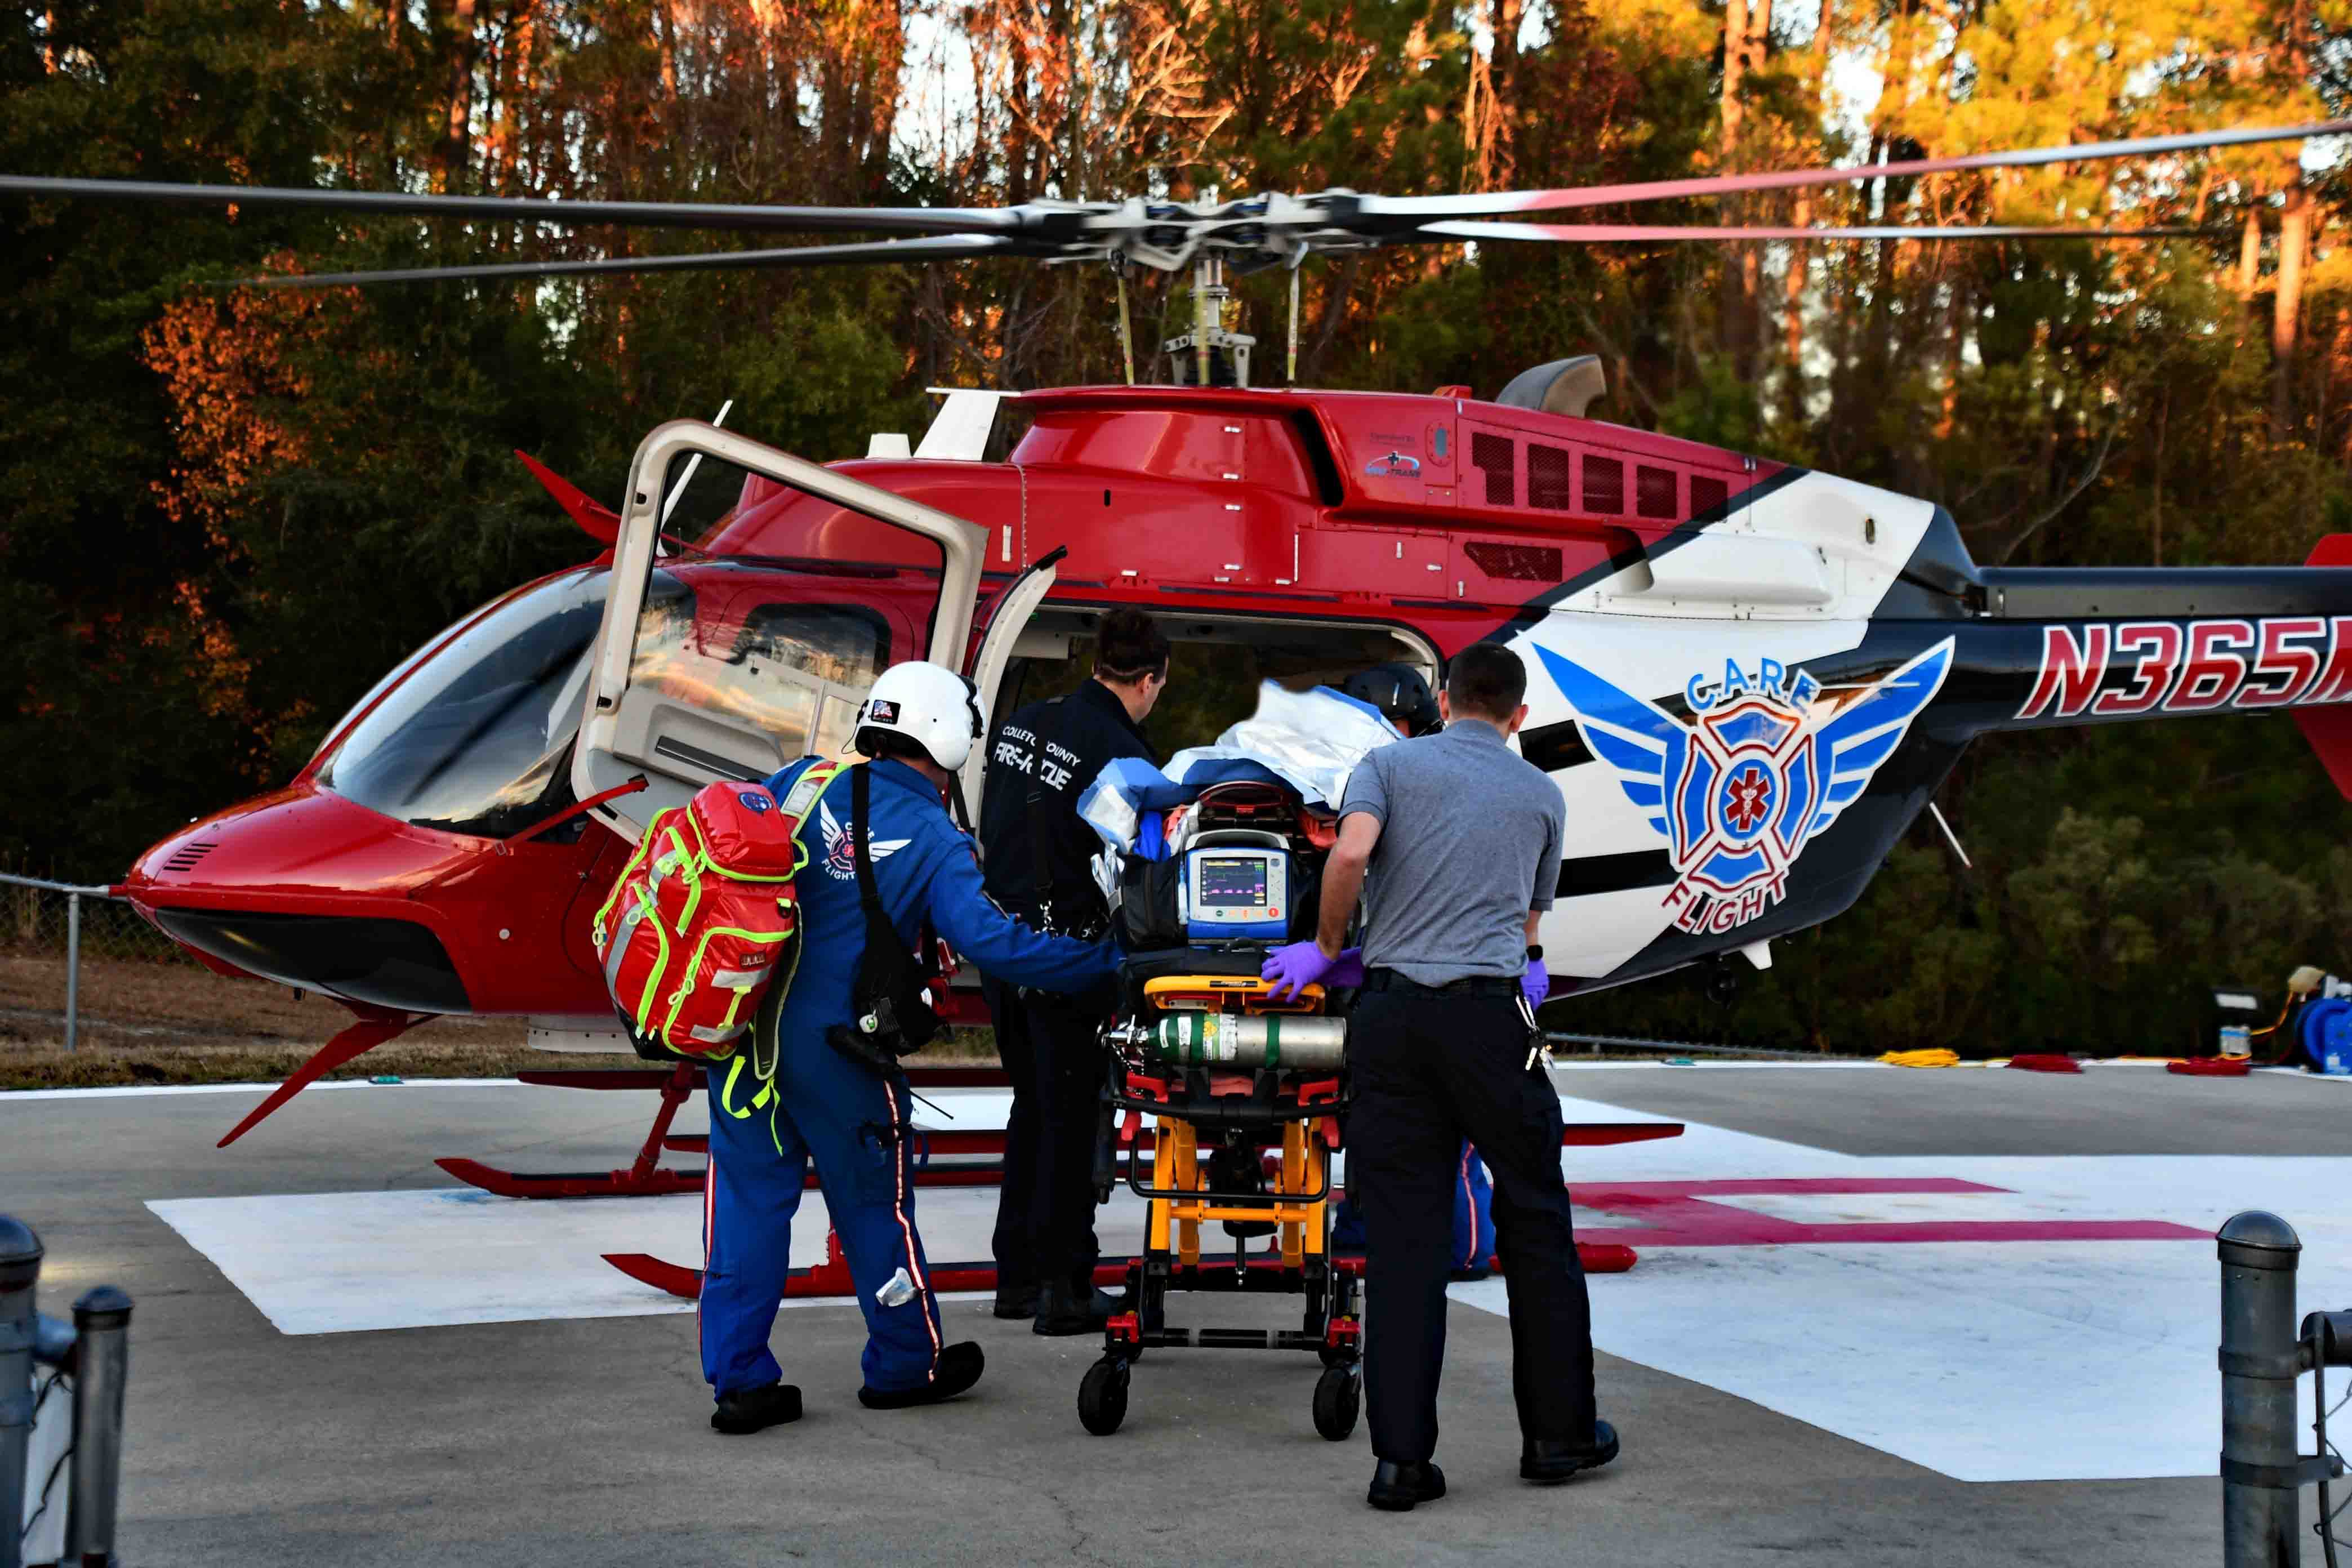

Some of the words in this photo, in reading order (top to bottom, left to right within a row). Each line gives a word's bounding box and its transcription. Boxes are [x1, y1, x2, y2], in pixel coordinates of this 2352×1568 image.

[1046, 741, 1081, 767] OUNTY
[822, 858, 856, 880] FLIGHT
[1661, 869, 1785, 931] FLIGHT
